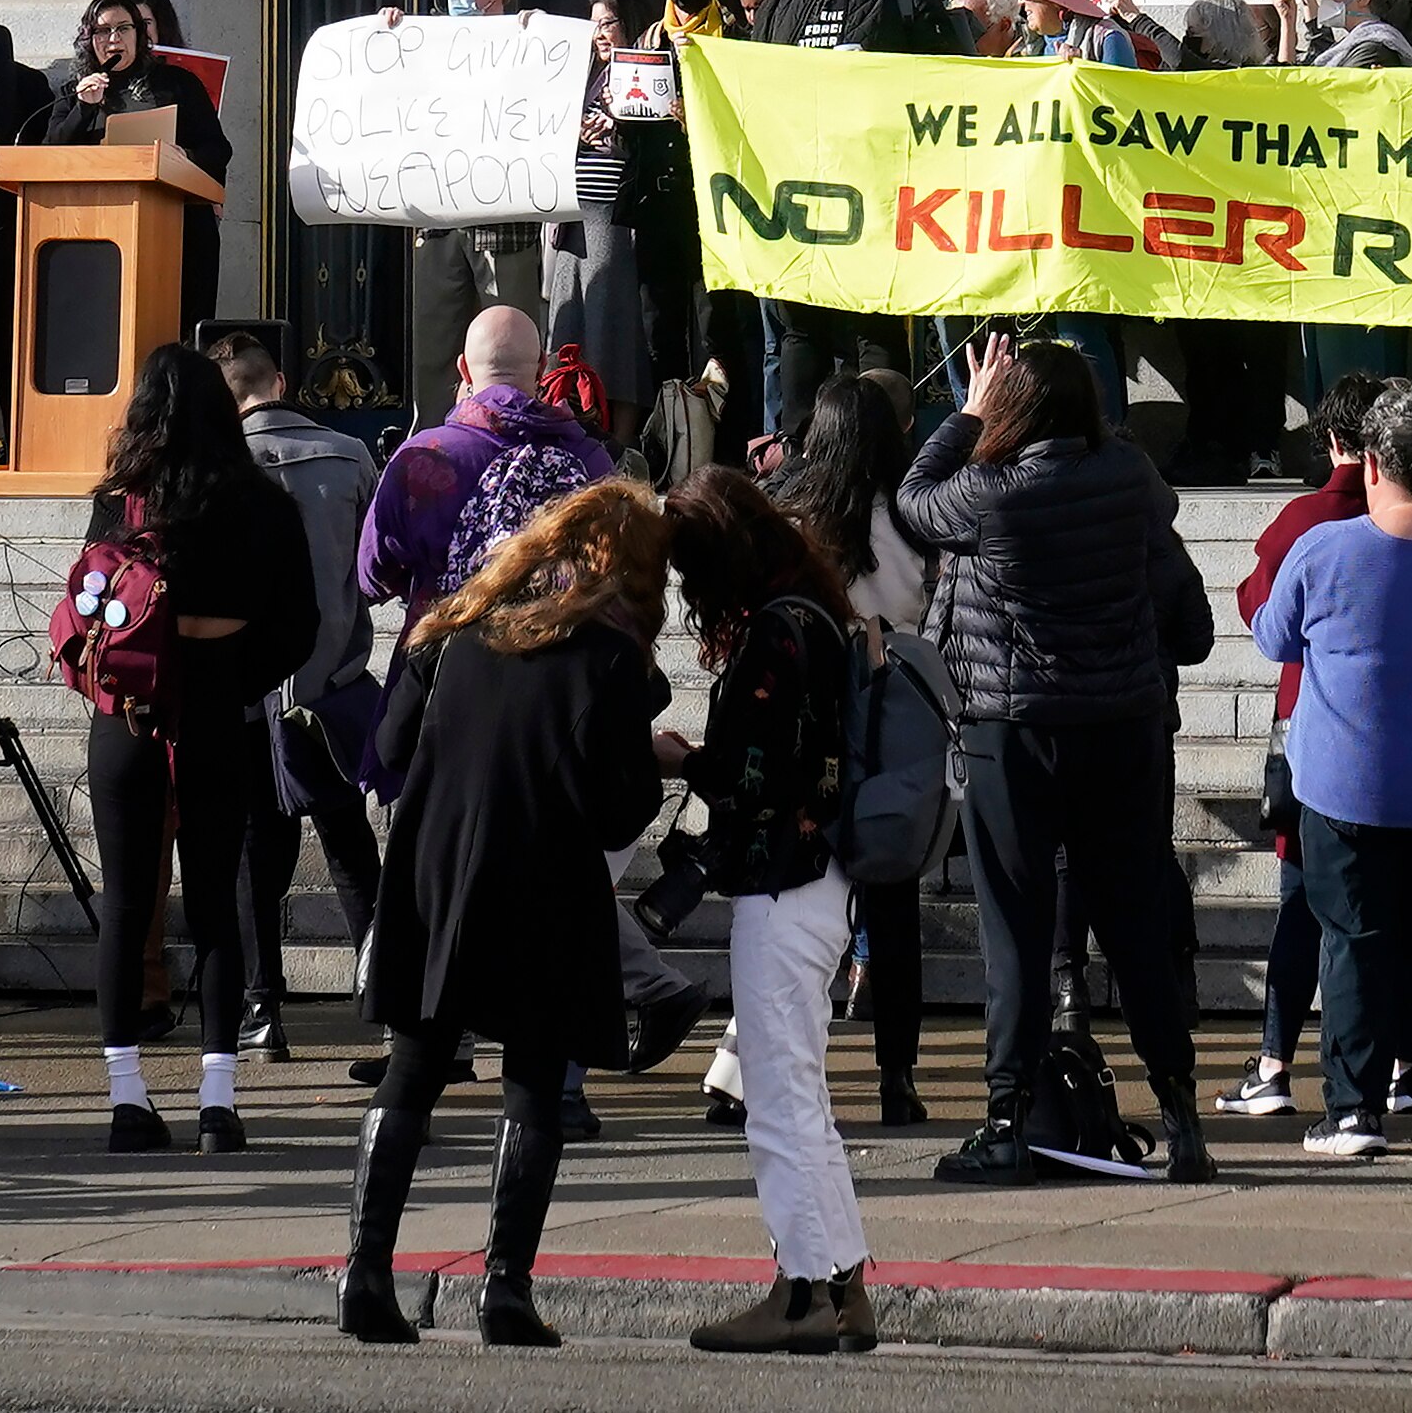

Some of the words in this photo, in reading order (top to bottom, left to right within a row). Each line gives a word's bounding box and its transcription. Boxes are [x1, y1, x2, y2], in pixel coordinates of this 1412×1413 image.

[312, 25, 425, 81] STOP
[482, 95, 571, 142] NEW
[906, 102, 978, 148] WE
[993, 99, 1074, 146] ALL
[1089, 105, 1208, 156] SAW
[1222, 119, 1358, 171] THAT
[709, 172, 864, 246] NO
[895, 183, 1308, 272] KILLER
